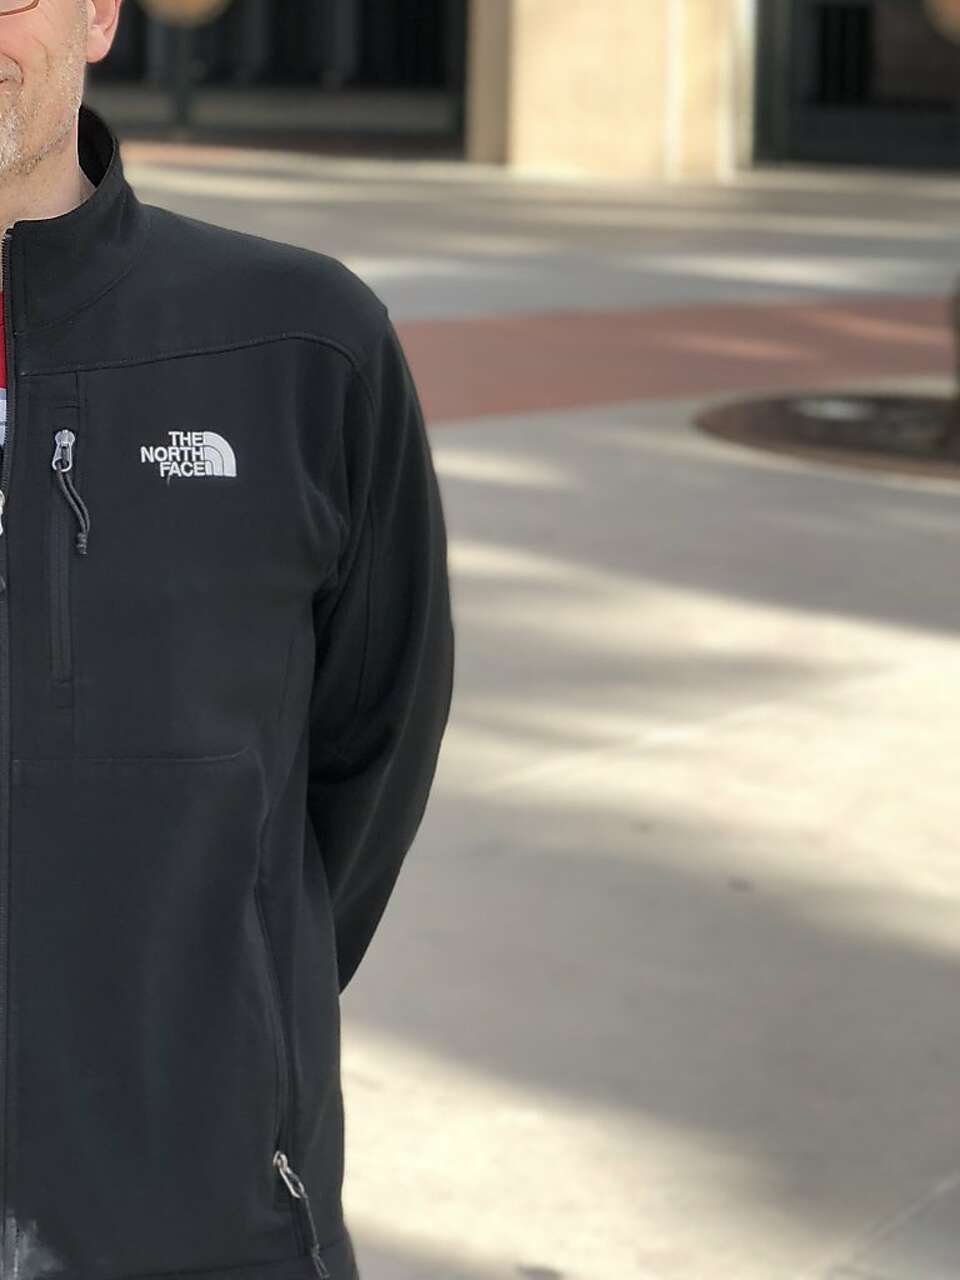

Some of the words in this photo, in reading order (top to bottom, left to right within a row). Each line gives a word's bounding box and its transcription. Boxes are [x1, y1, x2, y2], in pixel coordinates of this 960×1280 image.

[168, 431, 203, 446] THE
[140, 446, 203, 462] NORTH
[160, 461, 205, 477] FACE
